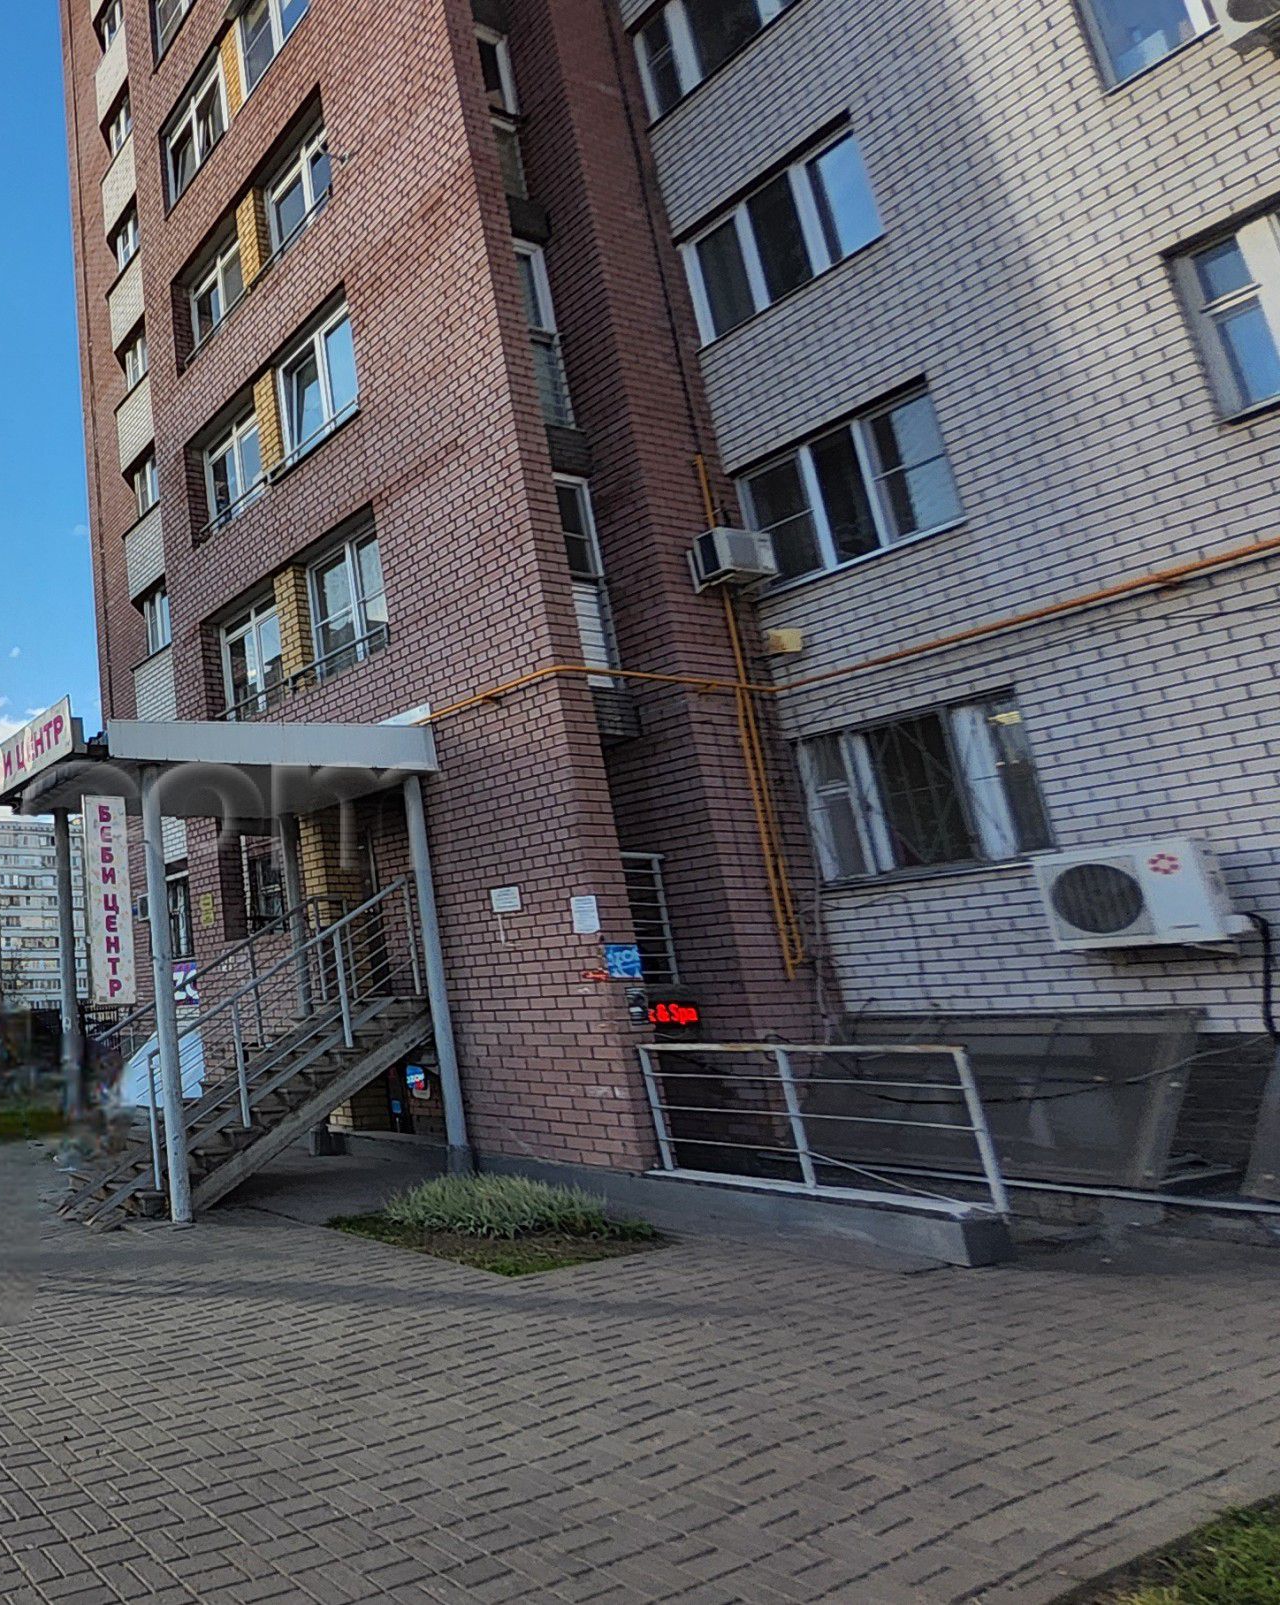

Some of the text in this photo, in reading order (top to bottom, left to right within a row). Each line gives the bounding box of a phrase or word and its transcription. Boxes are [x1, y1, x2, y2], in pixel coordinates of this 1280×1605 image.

[15, 714, 64, 772] ЦНТР
[97, 805, 123, 998] БЕБИ ЦЕНТР
[669, 1003, 699, 1025] Spa
